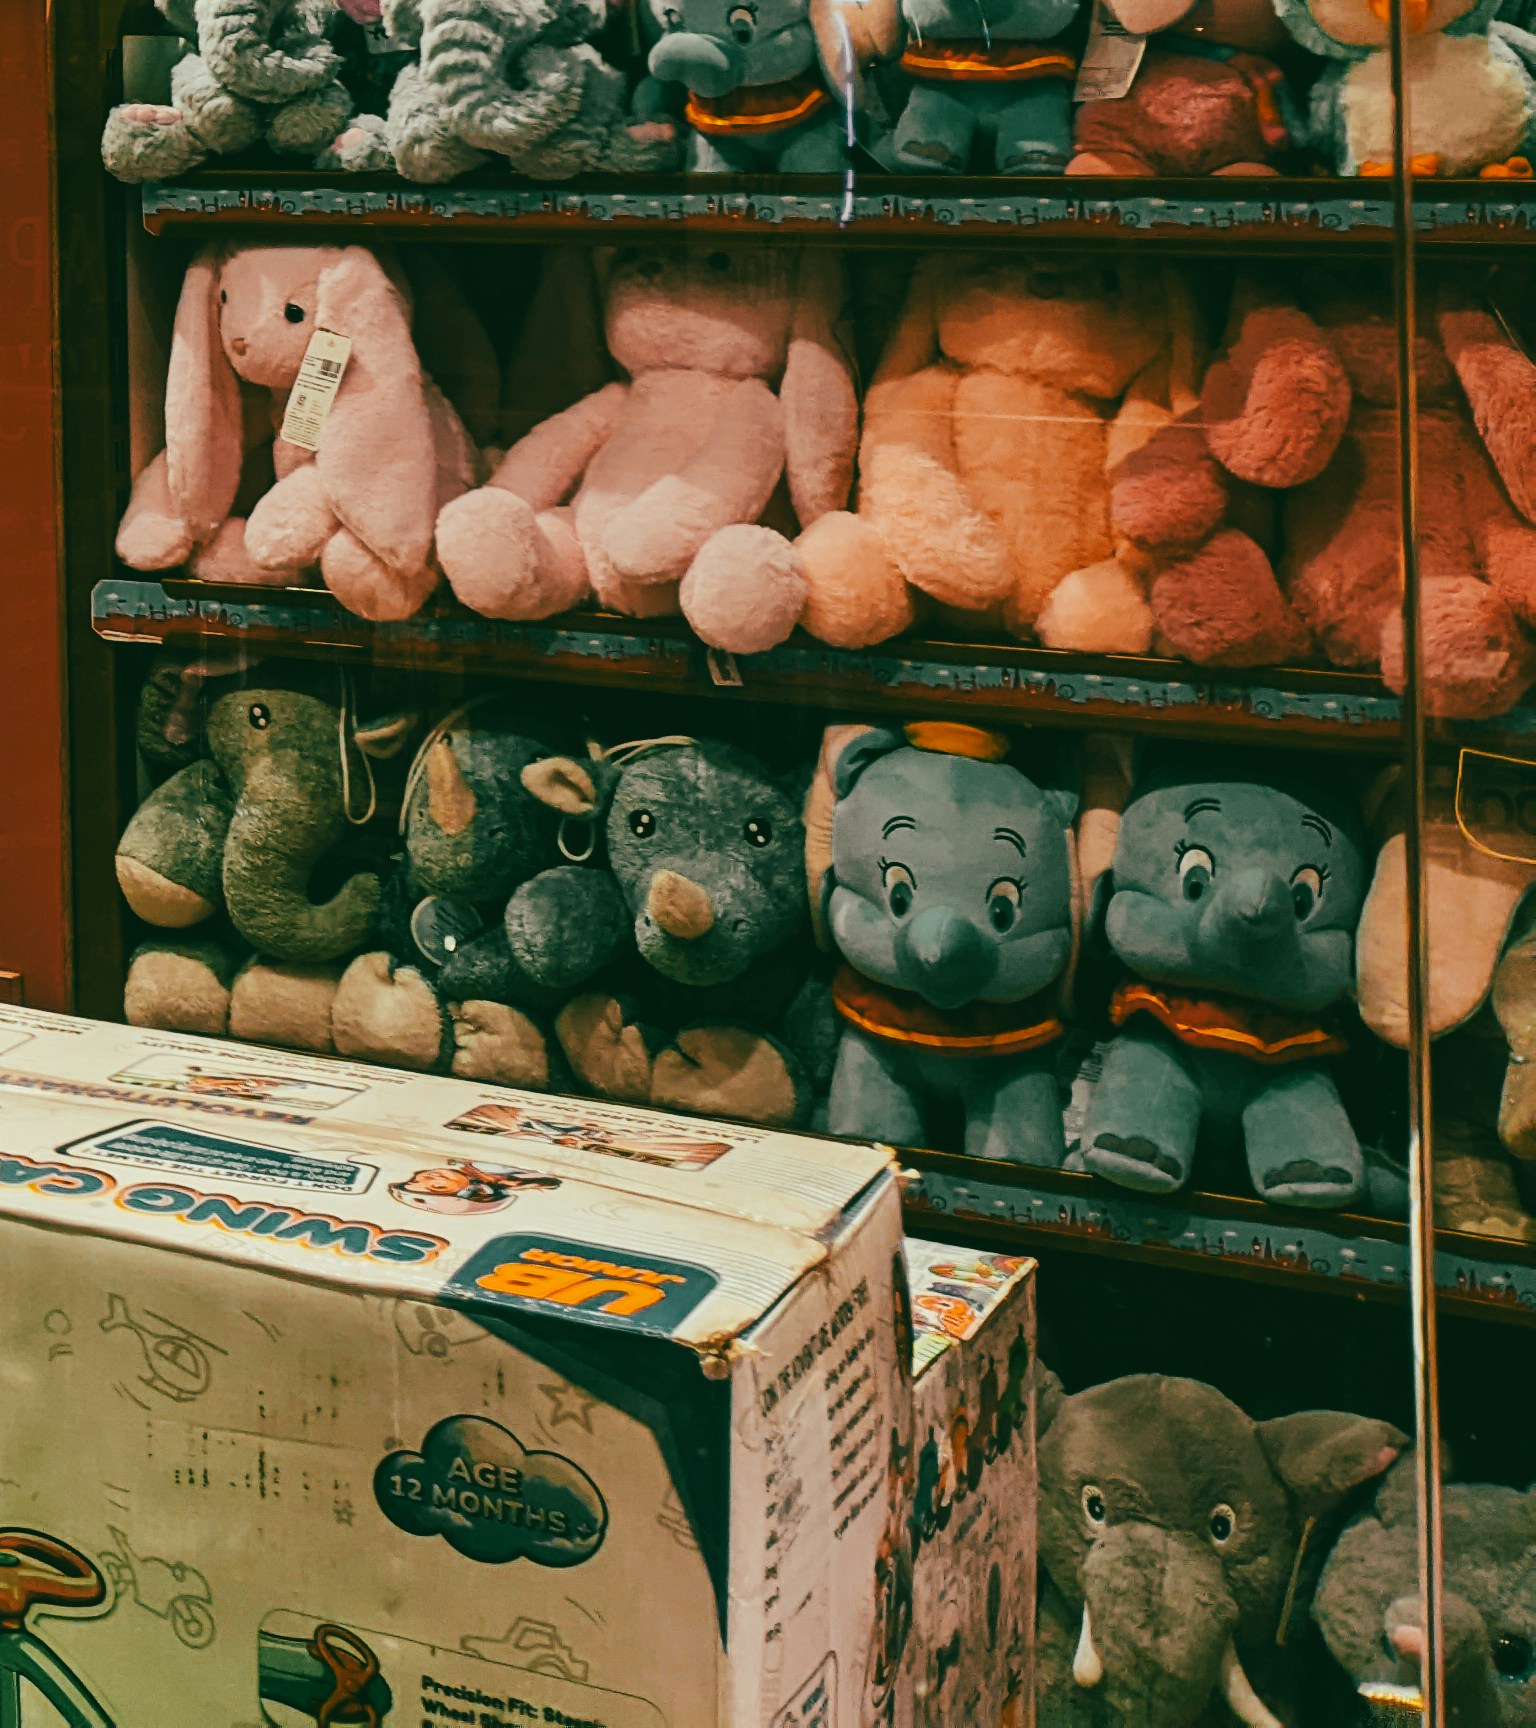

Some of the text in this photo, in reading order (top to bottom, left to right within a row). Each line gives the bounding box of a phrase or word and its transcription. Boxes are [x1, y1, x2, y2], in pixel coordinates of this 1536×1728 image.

[478, 1093, 760, 1145] LEAVE NO MARKS ON FLOOR
[173, 1163, 204, 1174] THE
[215, 1170, 288, 1186] FORGET
[116, 1182, 451, 1264] SWING
[519, 1248, 688, 1285] JUNIOR
[475, 1262, 666, 1316] UB
[448, 1456, 521, 1491] AGE
[388, 1474, 423, 1502] 12
[432, 1483, 569, 1534] MONTHS
[420, 1696, 476, 1725] Wheel
[421, 1674, 505, 1711] Precision
